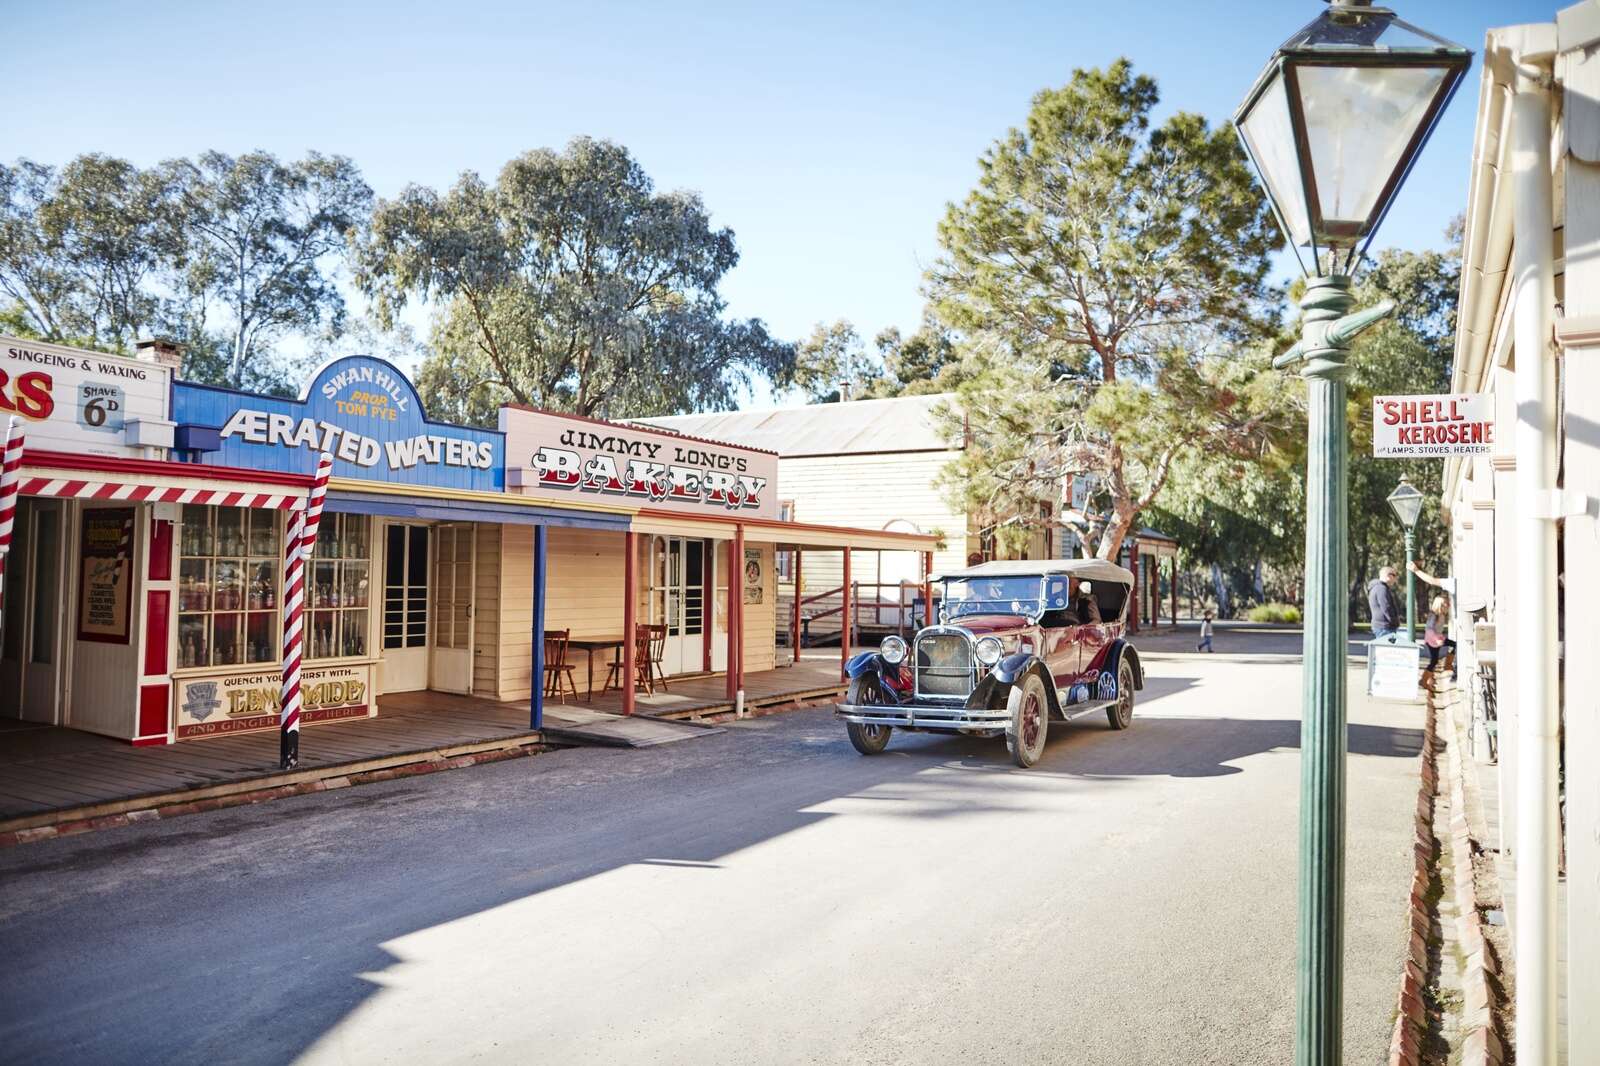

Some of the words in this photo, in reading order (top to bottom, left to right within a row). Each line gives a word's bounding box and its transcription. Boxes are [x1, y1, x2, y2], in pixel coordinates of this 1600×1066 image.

[8, 348, 76, 369] SINGEING
[81, 360, 91, 371] &
[98, 363, 146, 380] WAXING
[83, 386, 117, 398] SHAVE
[322, 367, 374, 400] SWAN
[375, 370, 409, 412] HILL
[336, 400, 367, 416] TOM
[371, 406, 397, 421] PYE
[219, 408, 381, 467] ÆRATED
[385, 434, 493, 469] WATERS
[1398, 422, 1494, 444] KEROSENE
[560, 429, 662, 459] JIMMY
[675, 447, 748, 472] LONG'S
[1454, 446, 1491, 454] HEATERS
[531, 446, 767, 509] BAKERY
[224, 676, 263, 687] QUENCH
[267, 674, 284, 683] YOU
[300, 671, 326, 680] HIRST
[225, 679, 366, 716] LEMNADE
[187, 724, 216, 735] AND
[221, 717, 274, 731] GINGER
